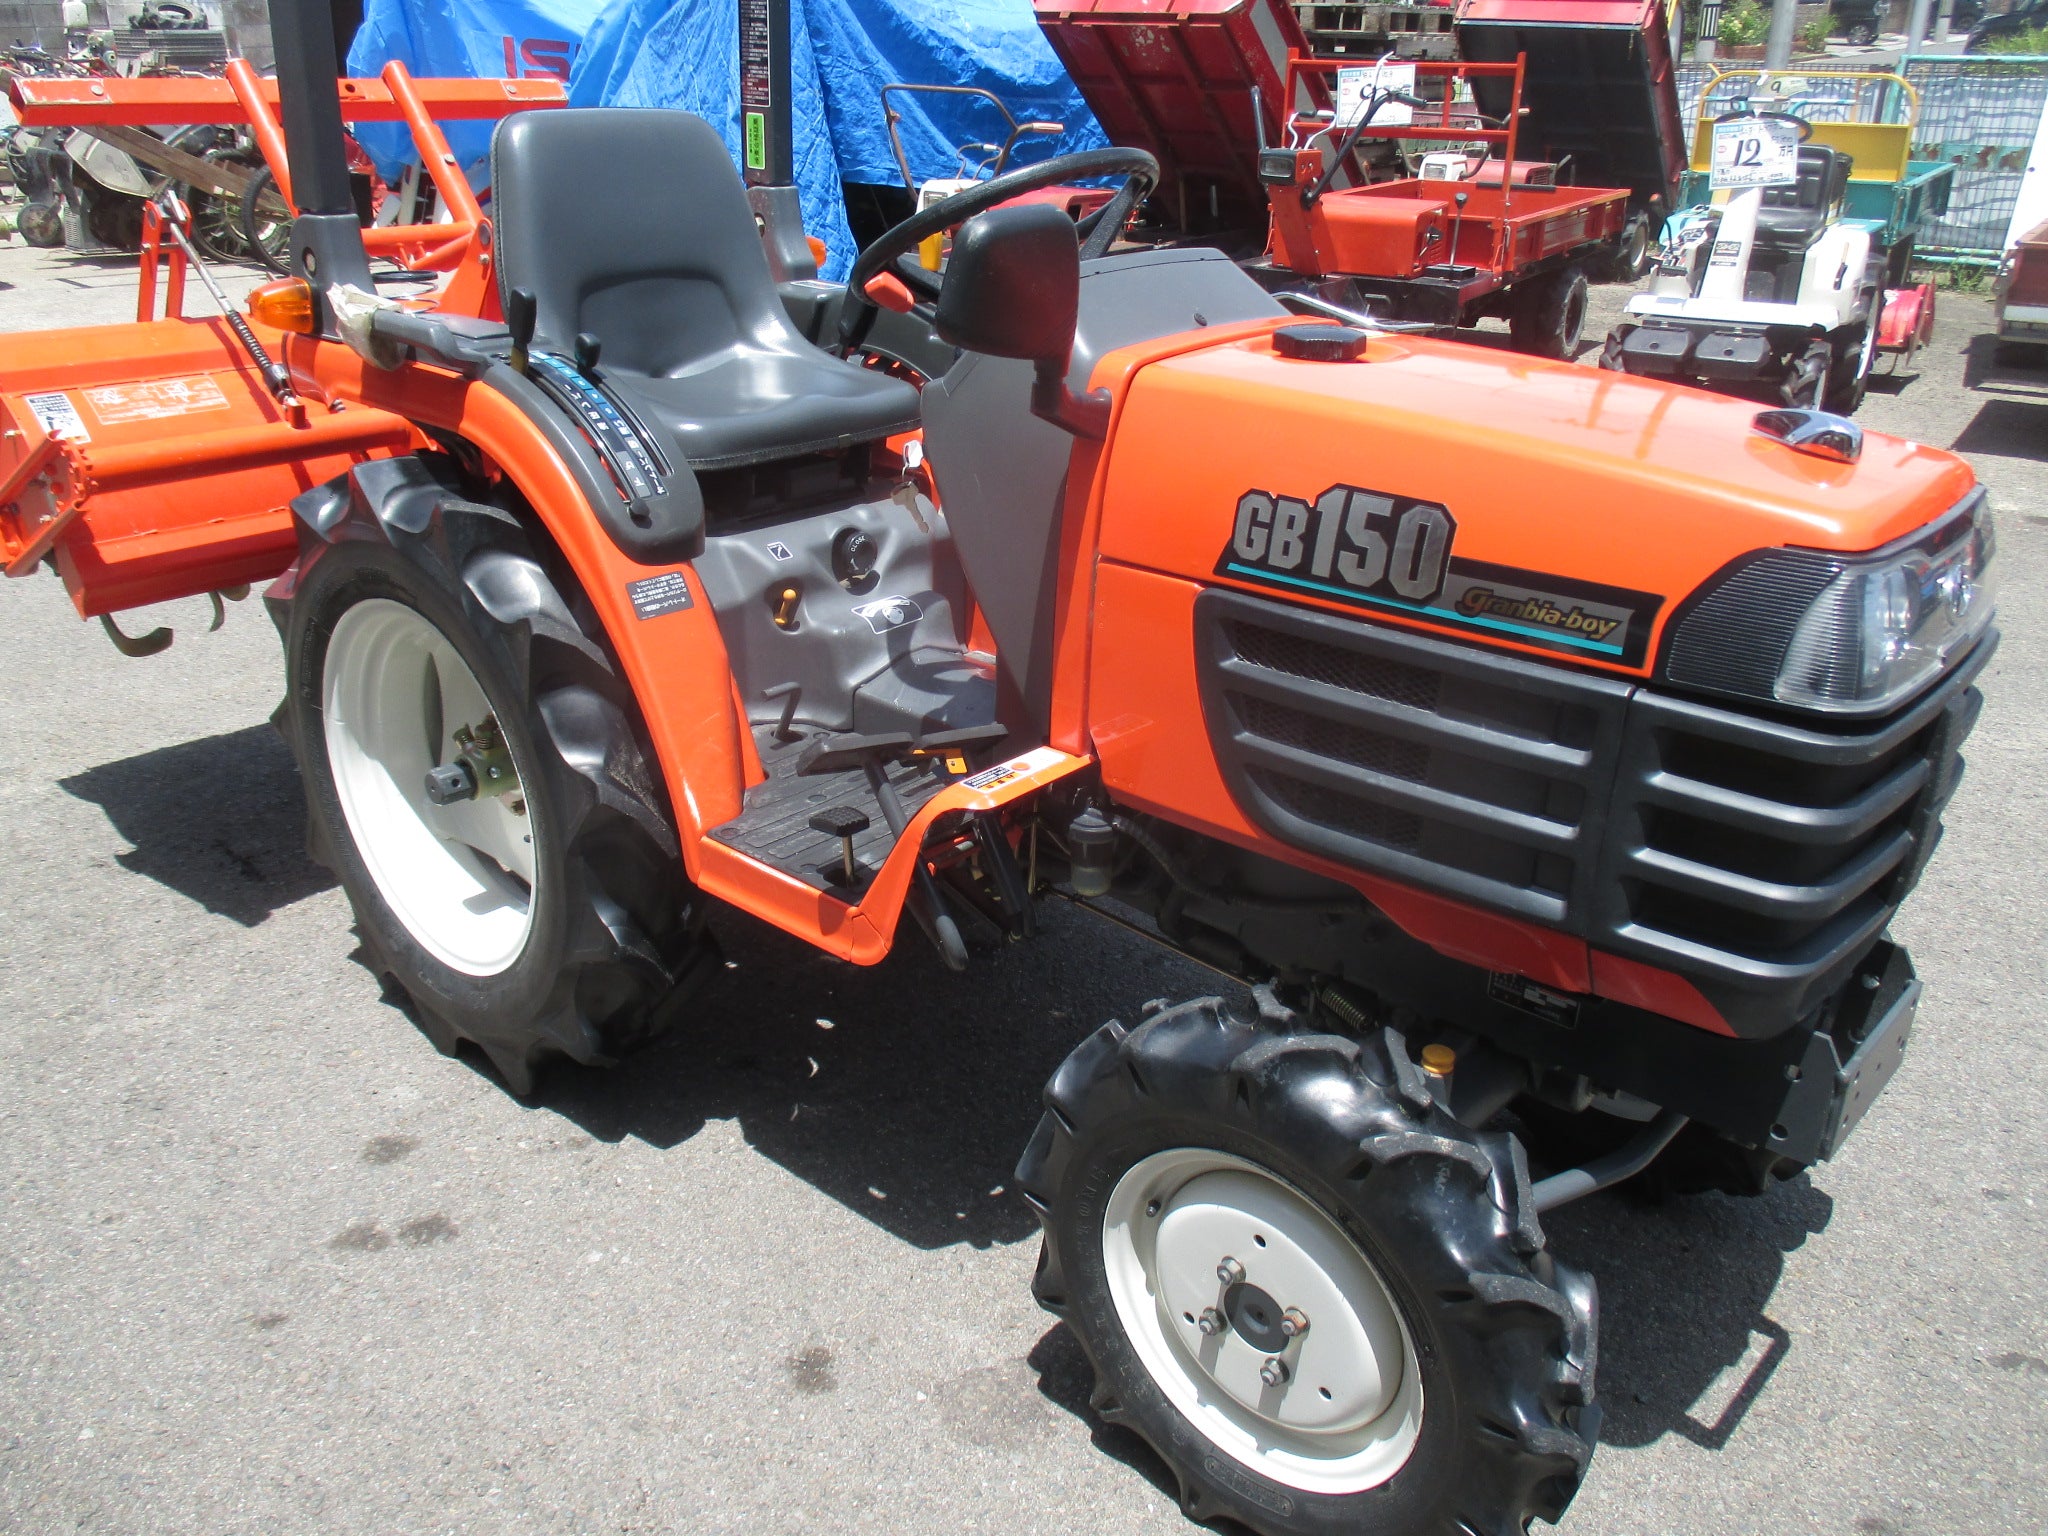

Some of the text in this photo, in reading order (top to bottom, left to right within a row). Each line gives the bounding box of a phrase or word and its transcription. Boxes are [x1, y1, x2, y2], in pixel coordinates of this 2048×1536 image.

[503, 36, 581, 83] IS
[1734, 139, 1762, 166] 12
[851, 535, 866, 552] CLOSE
[1232, 488, 1450, 600] GB150
